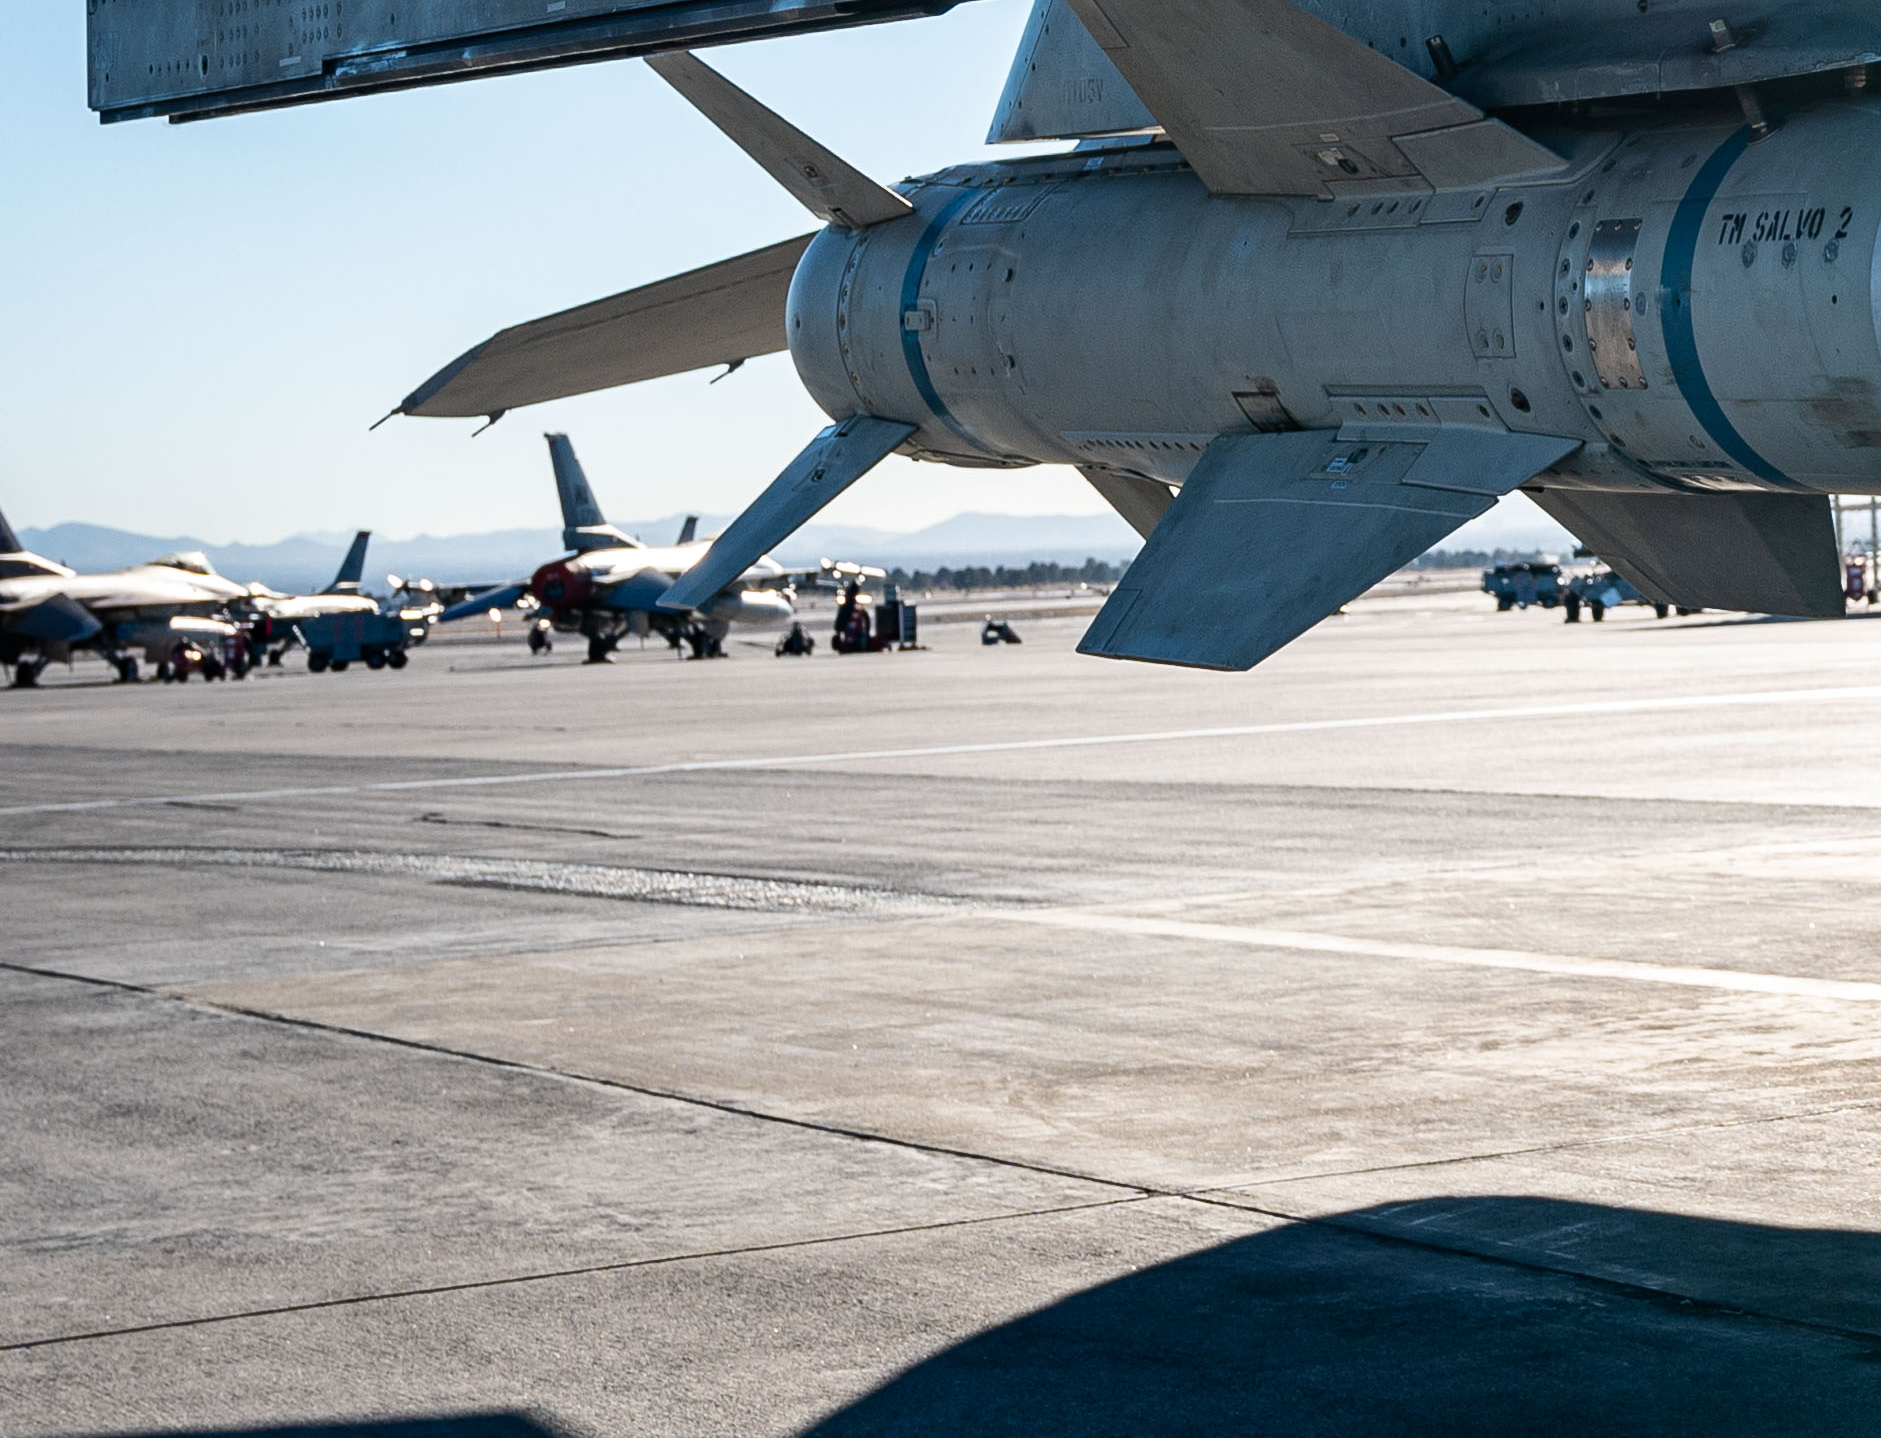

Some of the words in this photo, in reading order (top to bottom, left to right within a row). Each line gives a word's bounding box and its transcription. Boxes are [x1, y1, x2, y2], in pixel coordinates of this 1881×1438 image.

[1718, 212, 1748, 246] TM
[1751, 207, 1826, 243] SALVO
[1834, 205, 1854, 240] 2
